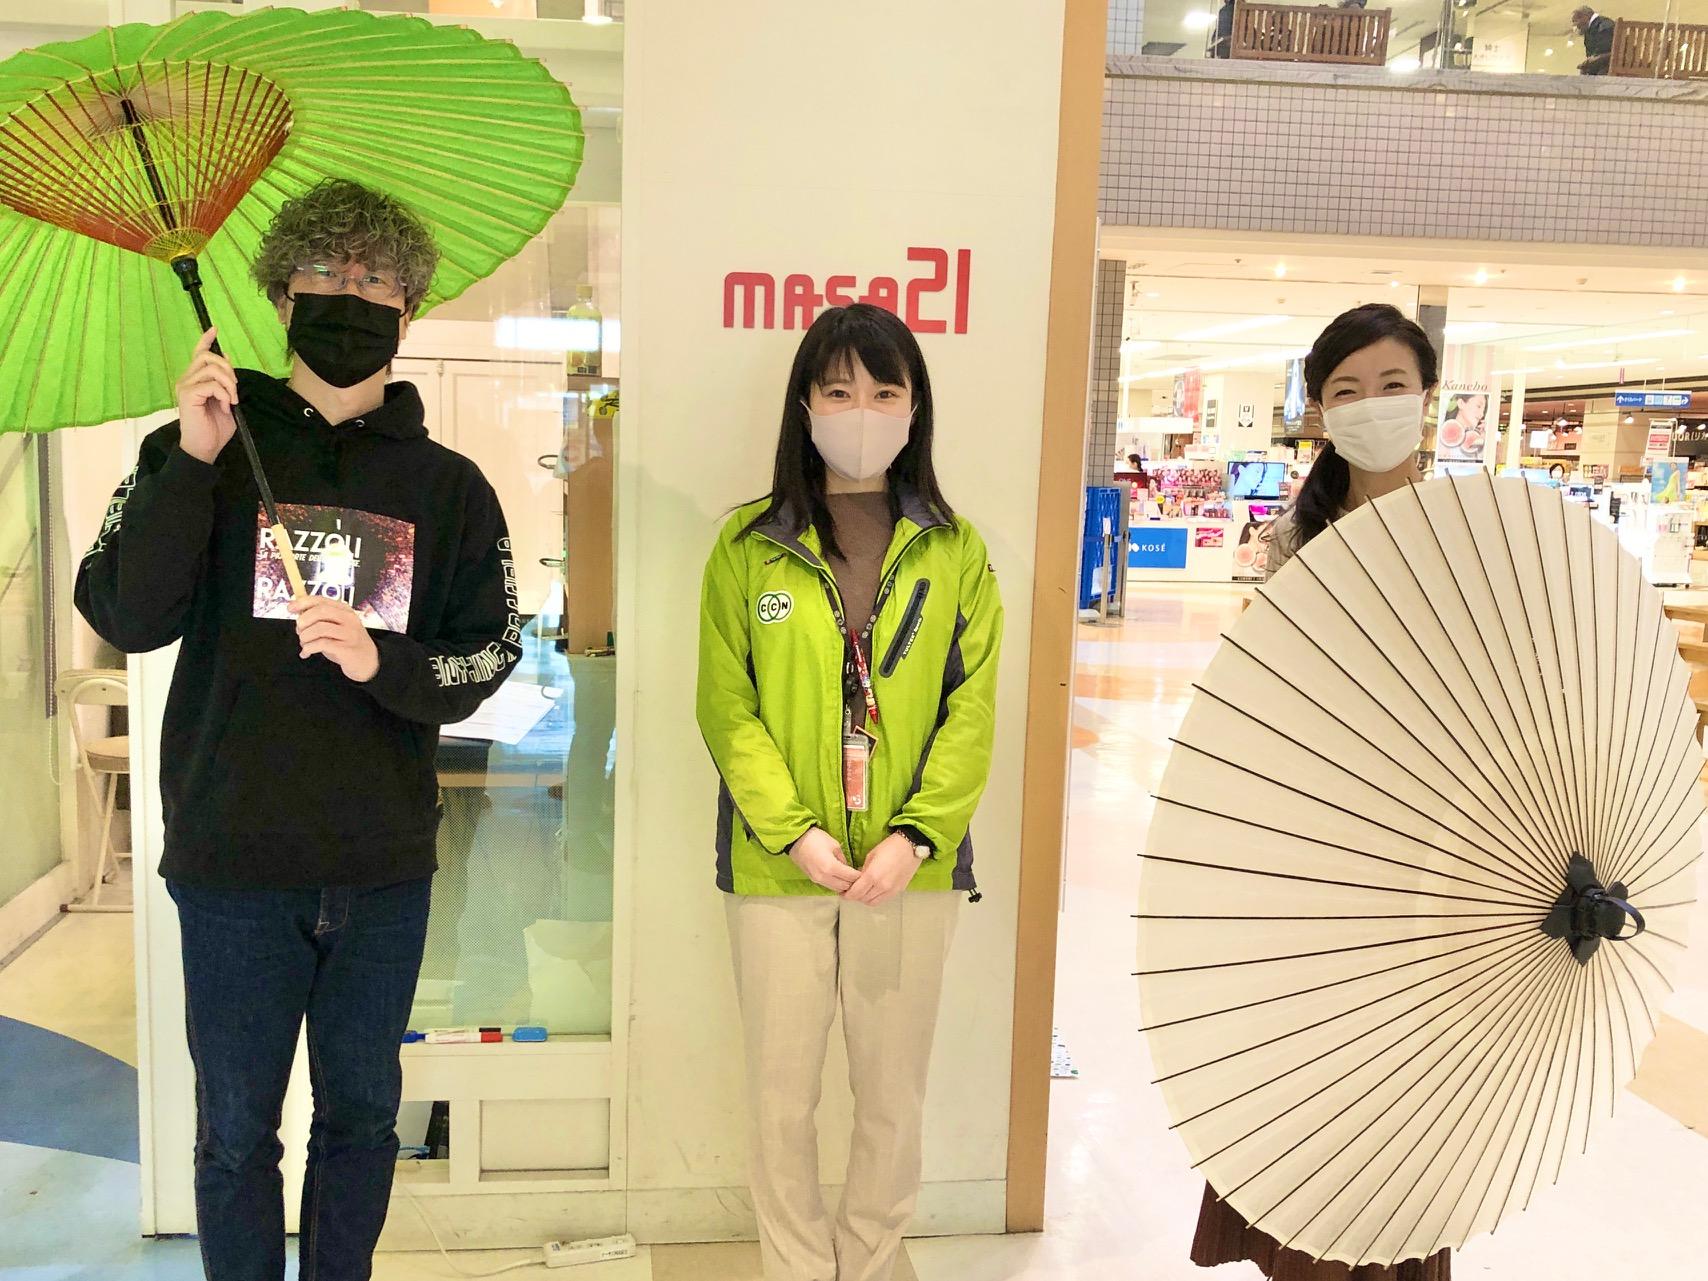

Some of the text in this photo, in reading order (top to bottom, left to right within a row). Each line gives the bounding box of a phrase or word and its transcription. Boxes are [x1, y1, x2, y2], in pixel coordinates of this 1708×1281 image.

[1442, 380, 1488, 391] Kanebo
[259, 528, 361, 558] RZZOLI
[1141, 543, 1166, 552] KOSÉ
[760, 601, 788, 612] CCN
